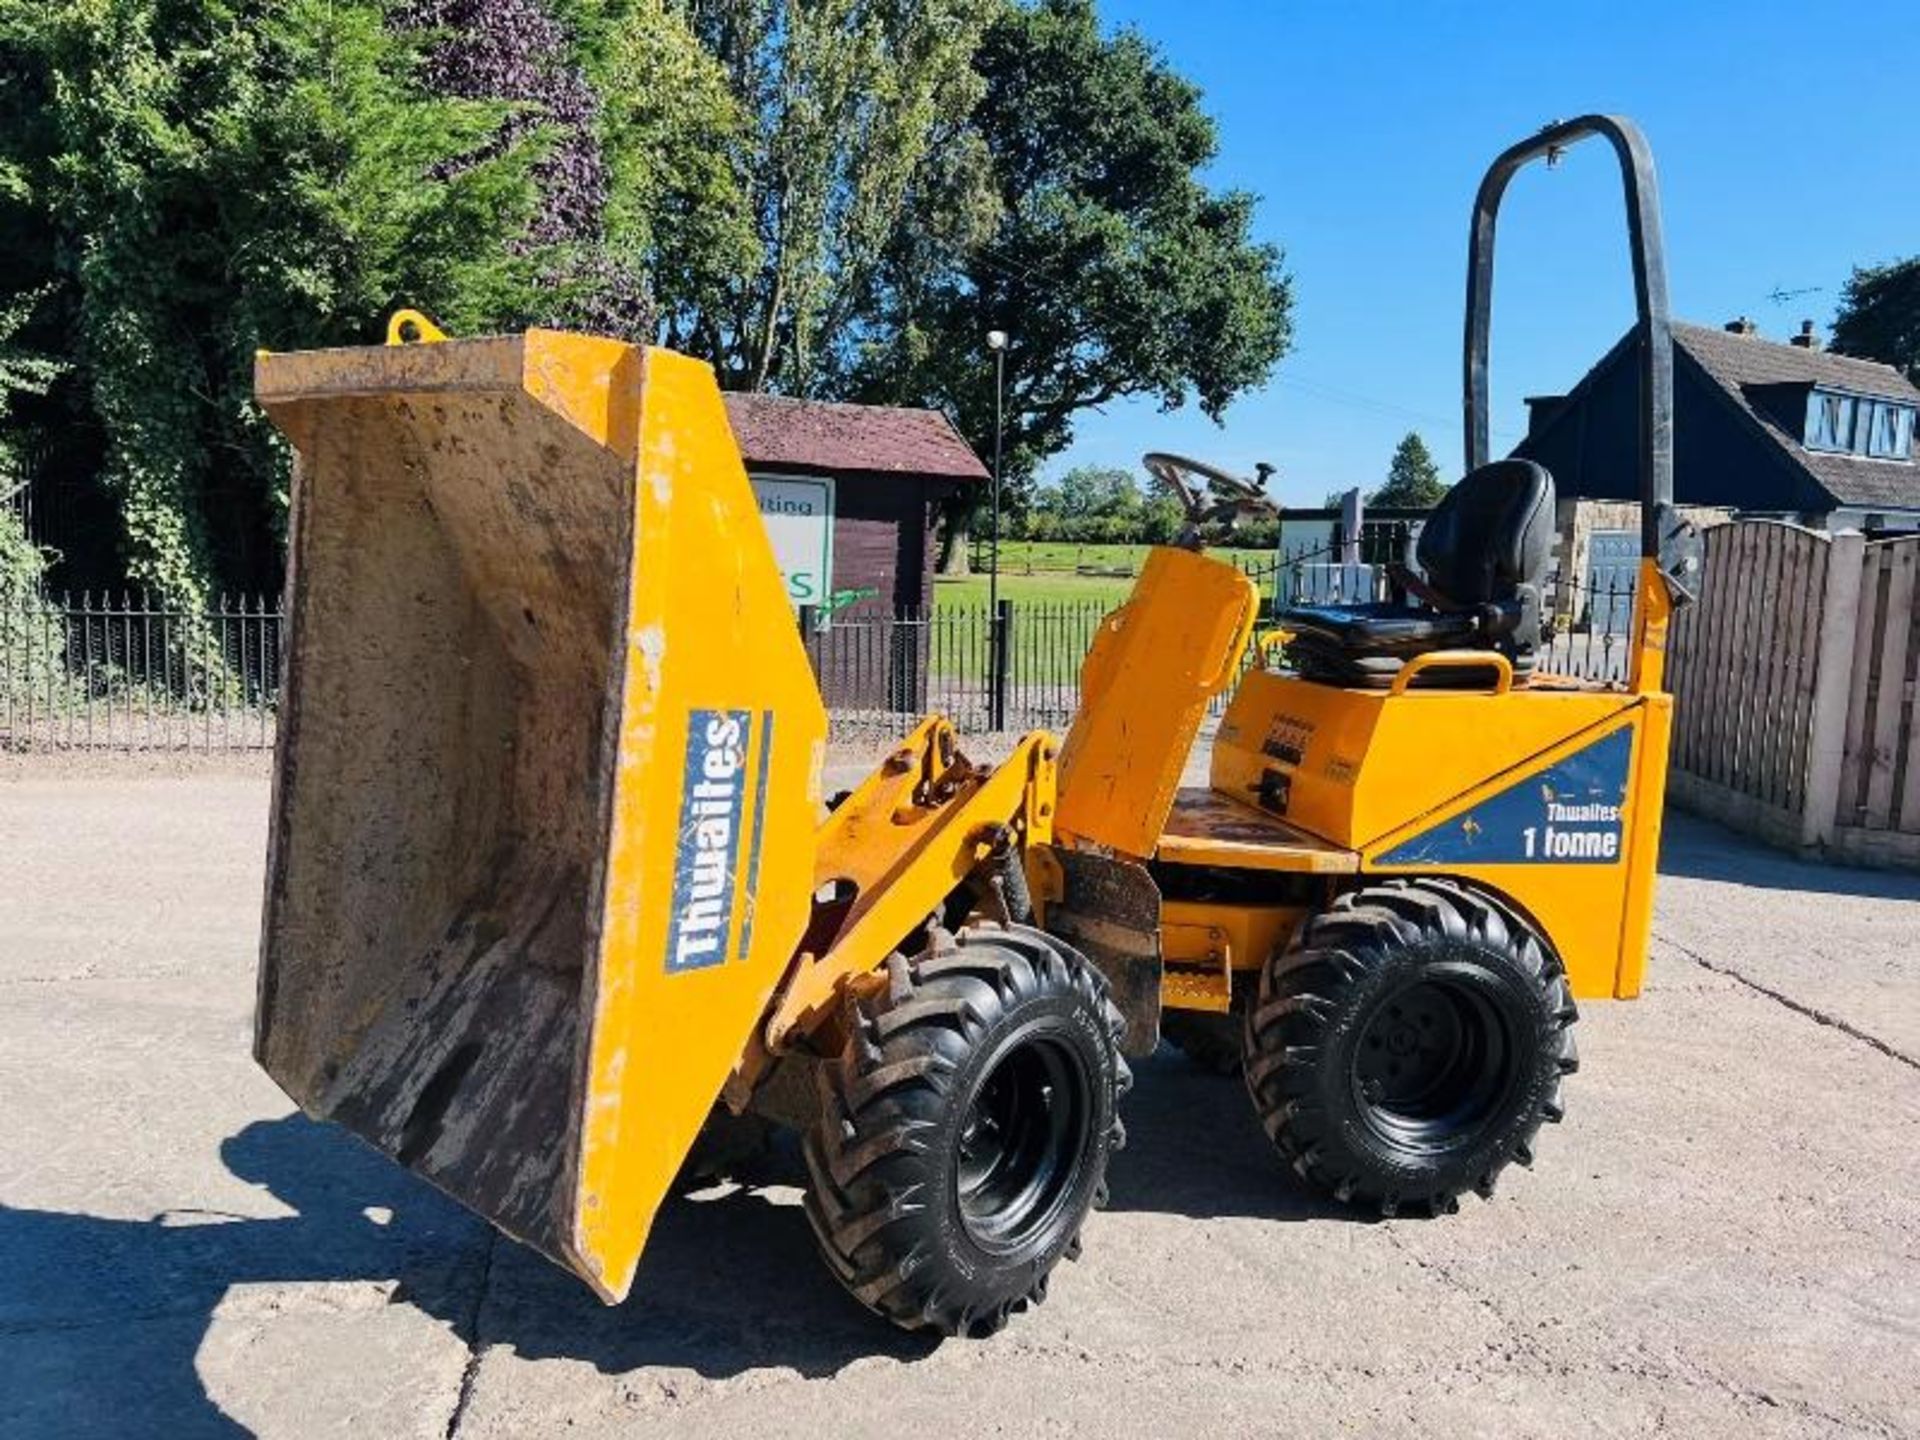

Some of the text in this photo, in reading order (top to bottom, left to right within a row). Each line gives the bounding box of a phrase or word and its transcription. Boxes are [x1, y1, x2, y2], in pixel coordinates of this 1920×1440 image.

[1547, 803, 1618, 821] Thwaites
[676, 718, 741, 964] Thwaites
[1523, 826, 1618, 858] 1 tonne
